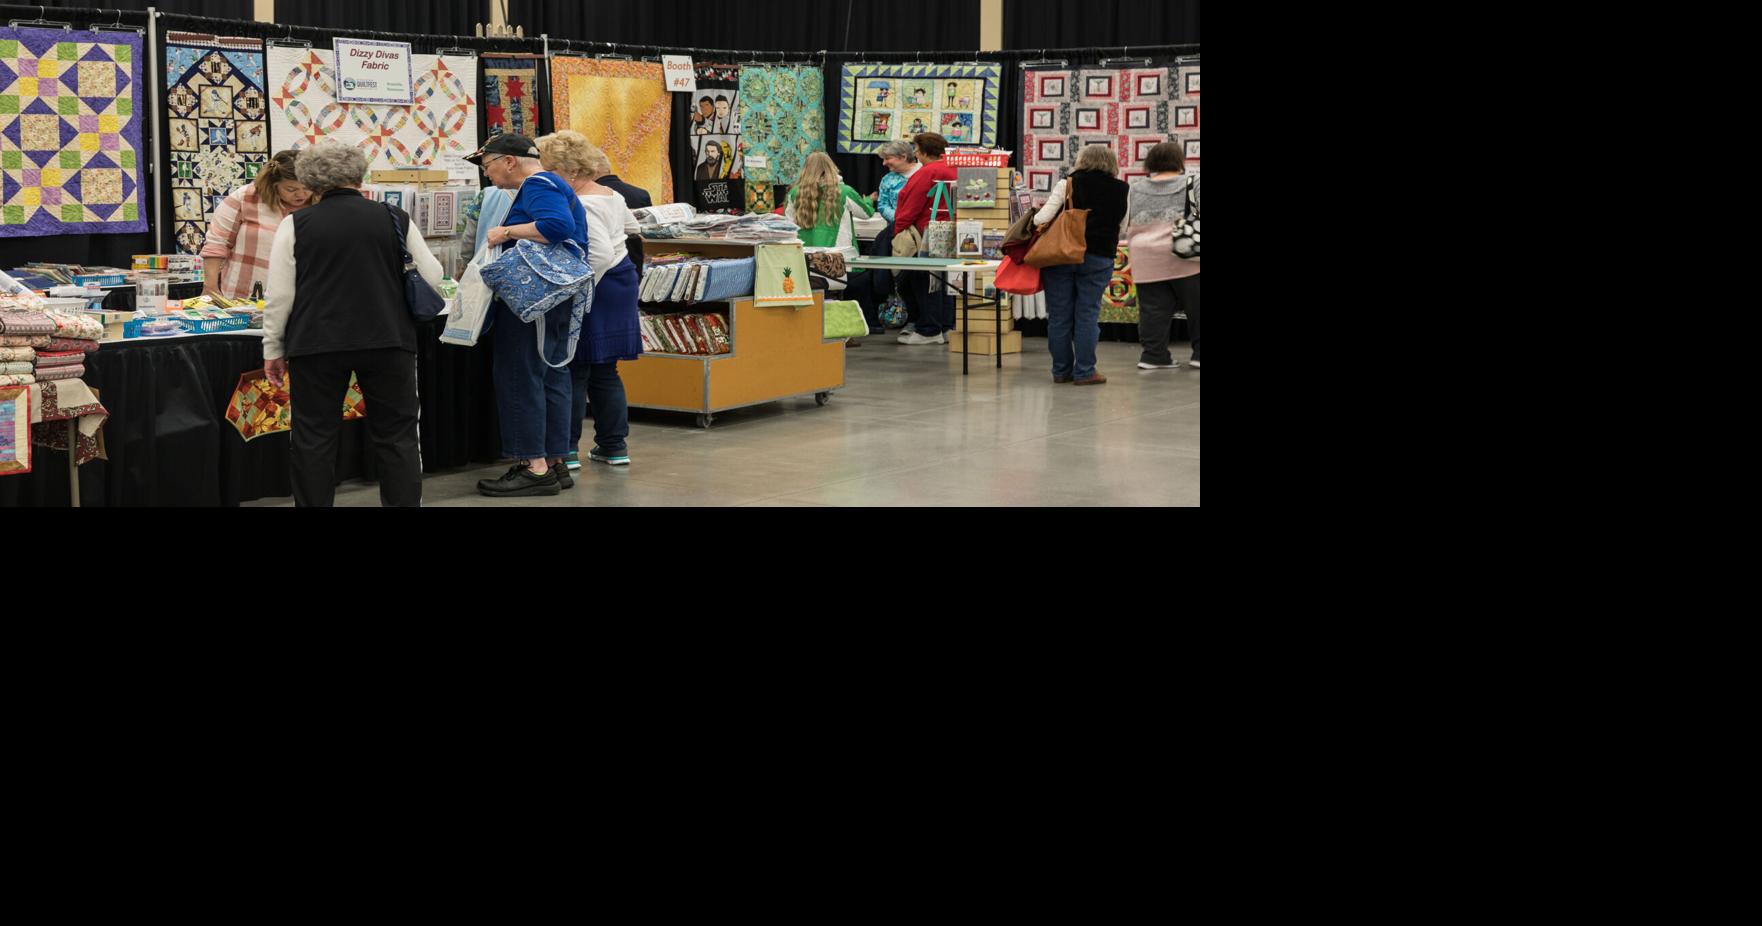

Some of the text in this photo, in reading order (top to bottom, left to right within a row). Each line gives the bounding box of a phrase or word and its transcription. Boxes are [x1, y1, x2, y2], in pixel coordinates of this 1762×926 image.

[350, 48, 400, 60] Dizzy Divas
[361, 60, 390, 70] Fabric
[667, 60, 691, 70] Booth
[674, 77, 690, 87] #47
